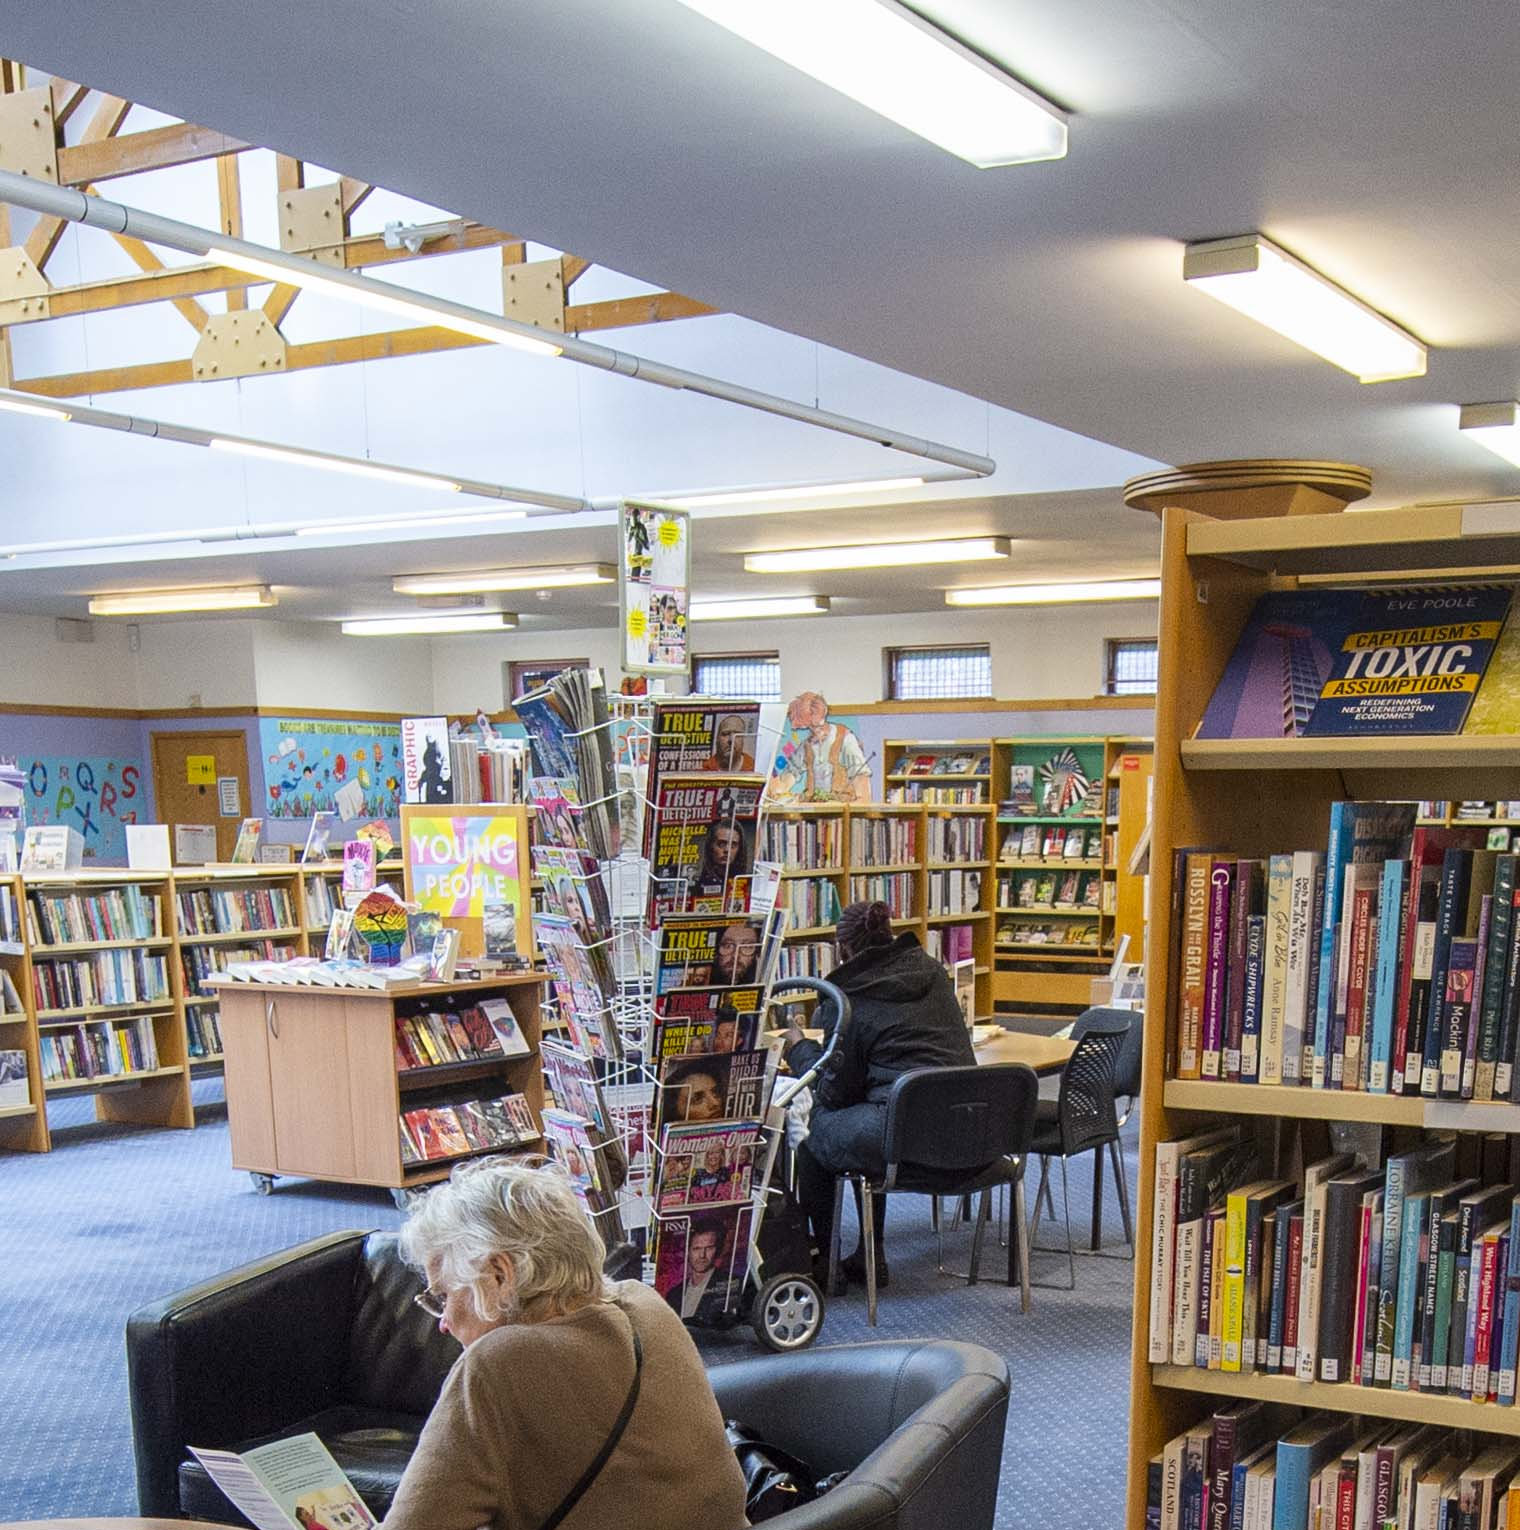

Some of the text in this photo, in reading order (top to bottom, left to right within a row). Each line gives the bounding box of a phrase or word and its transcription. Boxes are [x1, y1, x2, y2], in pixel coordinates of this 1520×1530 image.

[1355, 624, 1481, 649] CAPITALISM'S
[1344, 645, 1473, 679] TOXIC
[1331, 675, 1465, 697] ASSUMPTIONS
[1340, 704, 1435, 715] NEXT GENERATION
[1359, 697, 1422, 707] REDEFINING
[663, 713, 703, 731] TRUE
[1354, 712, 1415, 721] ECONOMICS
[403, 721, 417, 791] GRAPHIC
[665, 791, 704, 806] TRUE
[662, 808, 712, 820] DETECTIVE
[411, 835, 514, 865] YOUNG
[425, 874, 506, 898] PEOPLE
[668, 931, 707, 949] TRUE
[1185, 868, 1206, 990] ROSSLYN GRAIL
[665, 949, 715, 963] DETECTIVE
[727, 1131, 756, 1147] Own
[1426, 1212, 1440, 1315] GLASGOW STREET NAMES
[1201, 1249, 1211, 1320] THE ISLE OF SKYE
[1456, 1269, 1467, 1302] Scotland
[1478, 1247, 1494, 1331] West Highland Way
[1213, 1469, 1230, 1498] Mary
[1342, 1489, 1352, 1511] THIS
